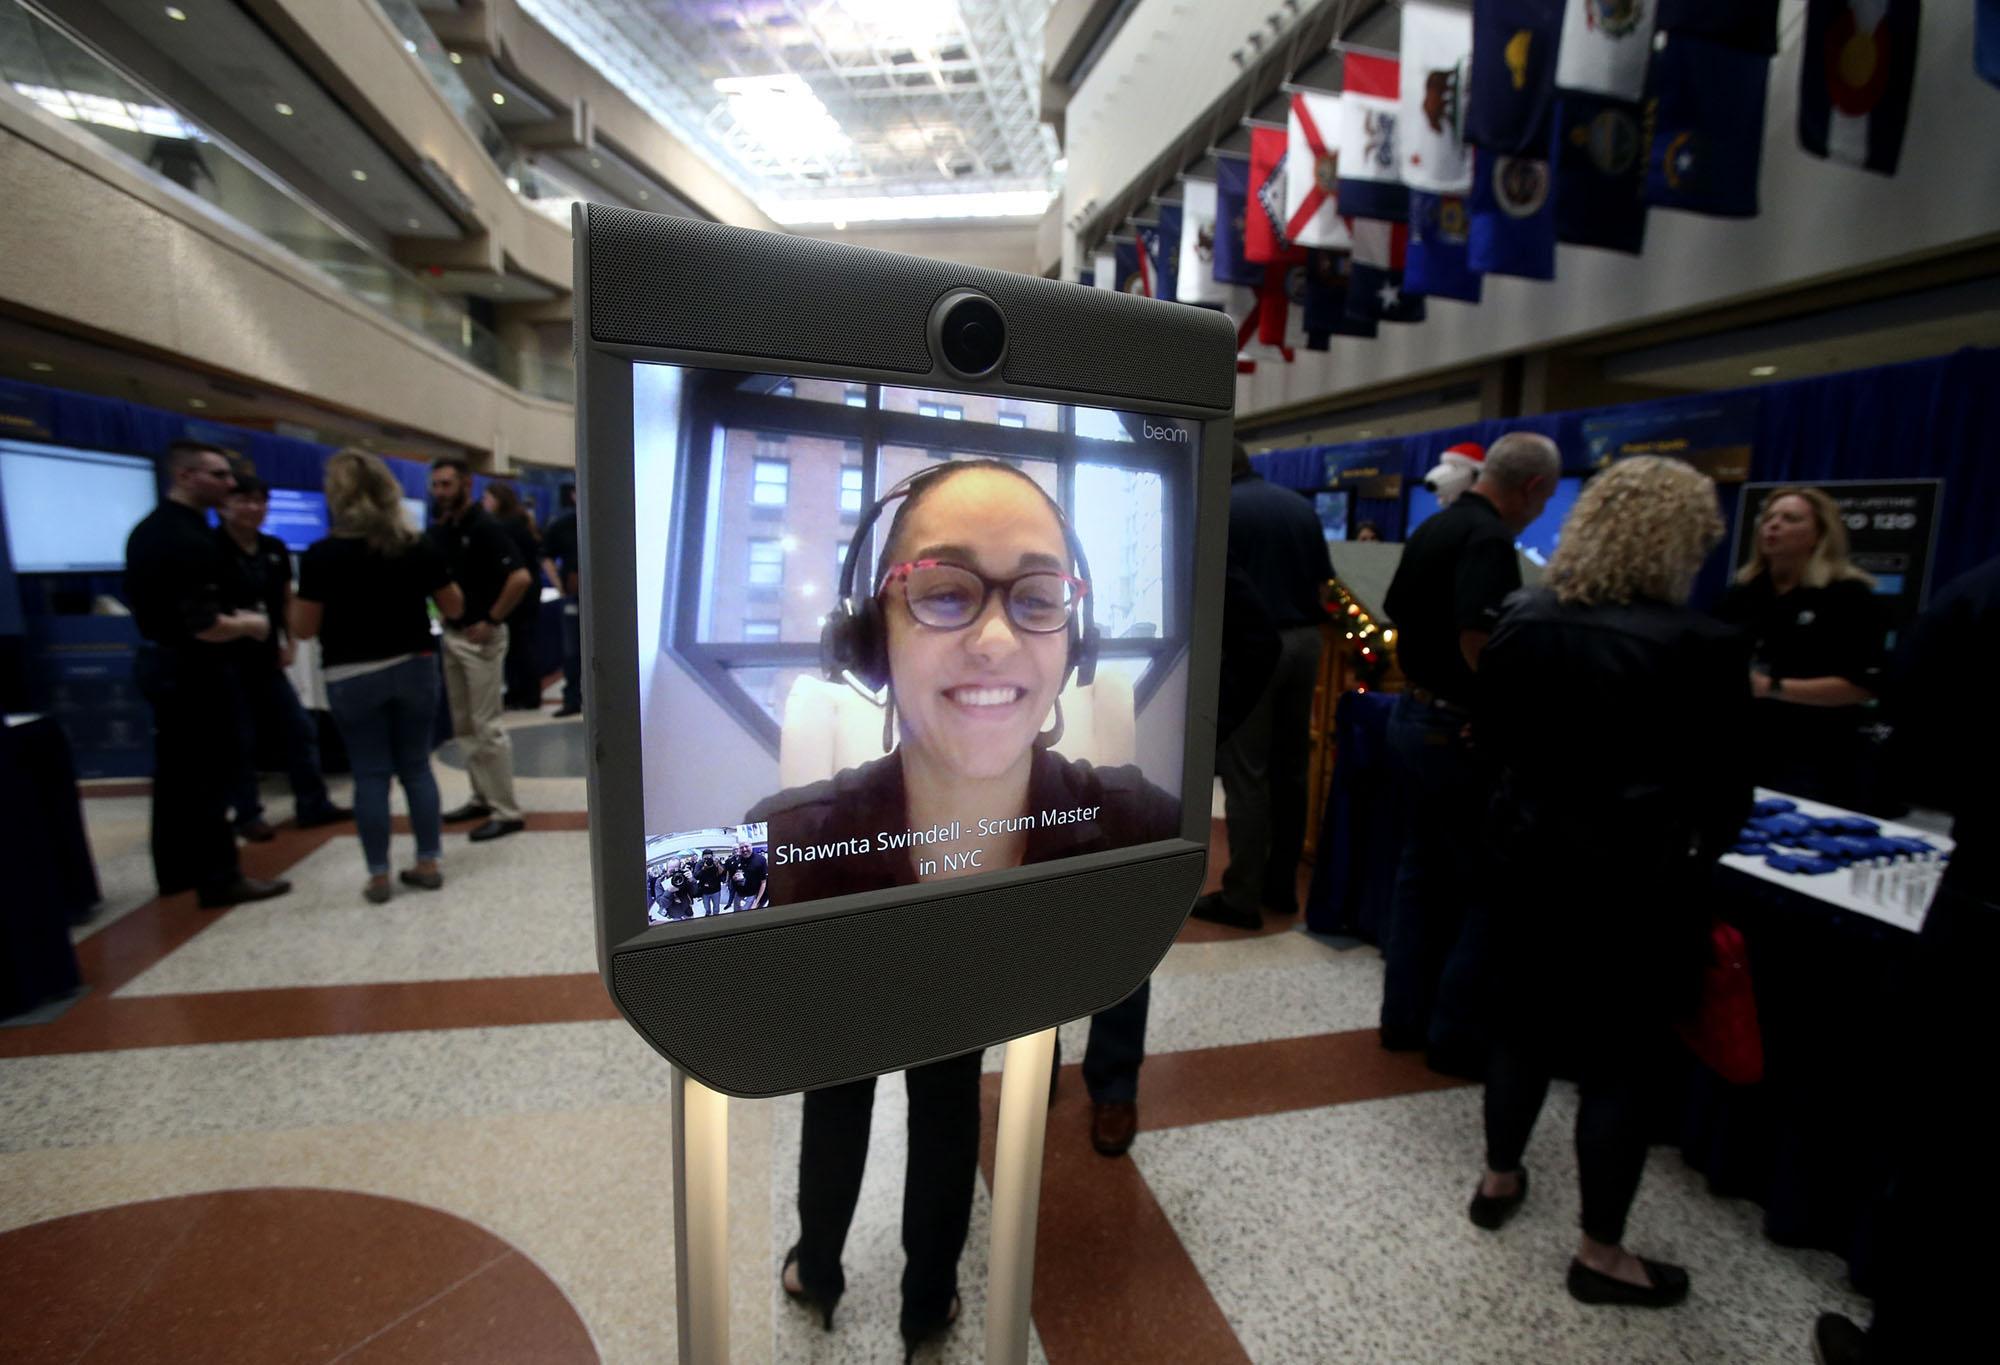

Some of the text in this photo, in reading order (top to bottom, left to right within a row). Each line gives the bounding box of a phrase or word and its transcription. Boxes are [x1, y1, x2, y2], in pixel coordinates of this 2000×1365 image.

[1143, 419, 1188, 443] beam
[775, 837, 870, 865] Shawnta
[877, 822, 960, 851] Swindell
[978, 815, 1035, 837] Scrum
[1041, 806, 1100, 828] Master
[919, 849, 983, 876] in NYC
